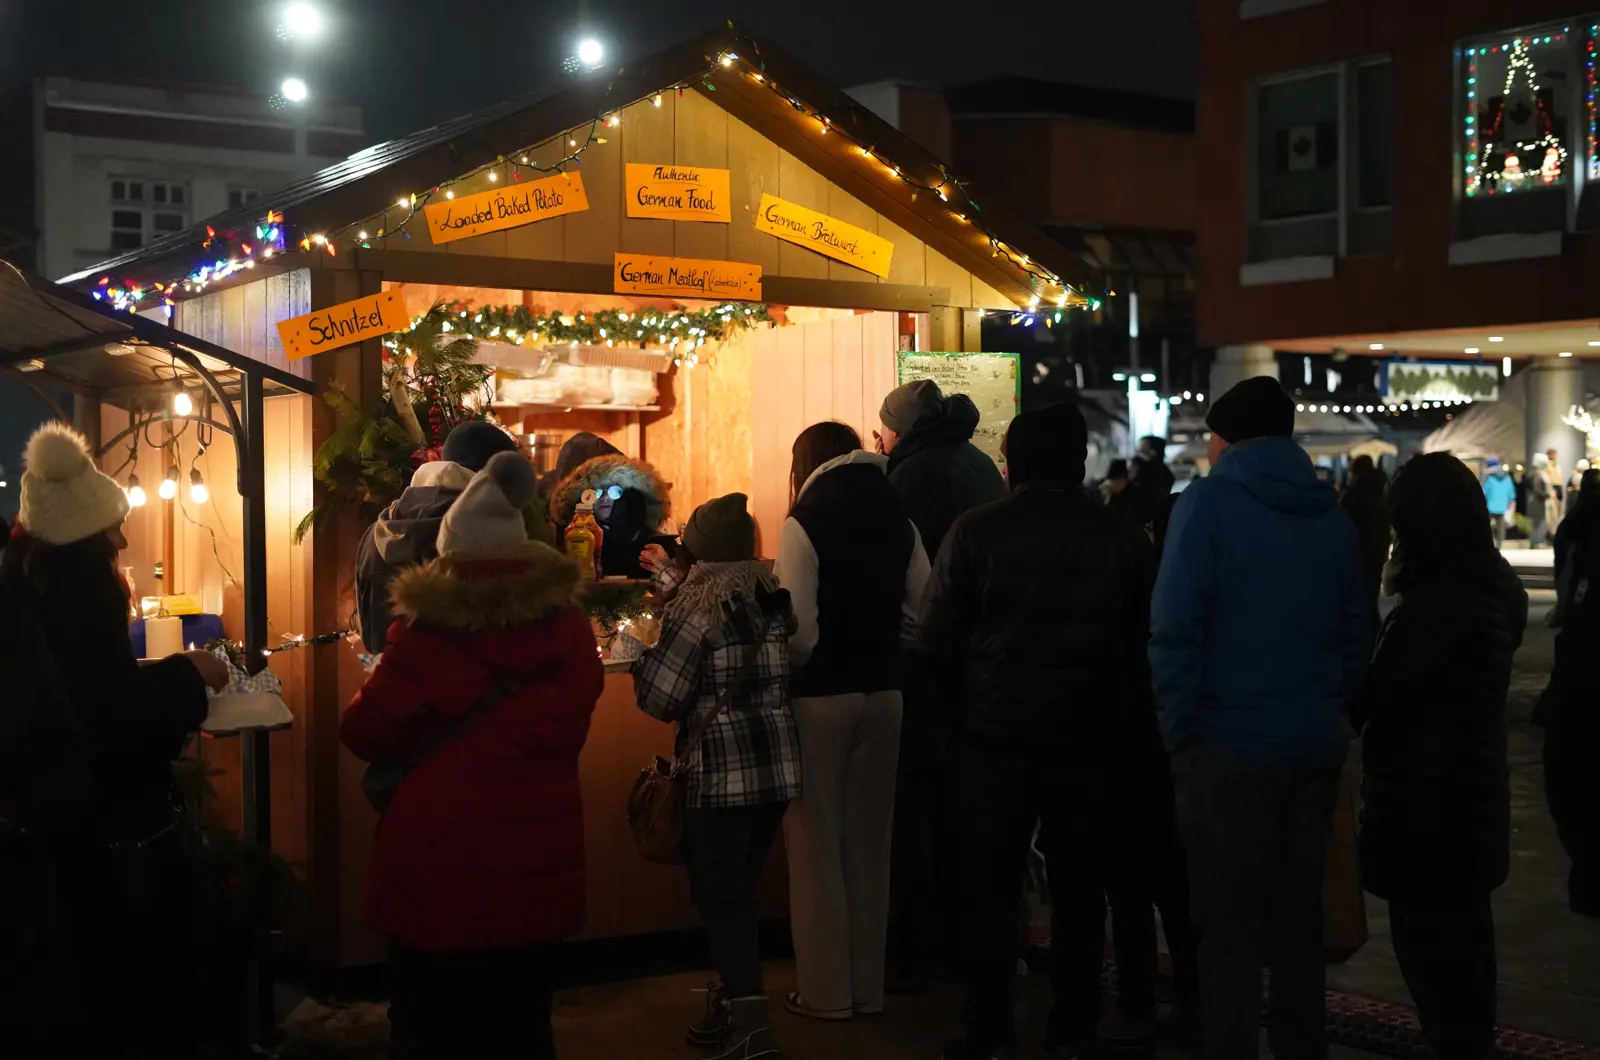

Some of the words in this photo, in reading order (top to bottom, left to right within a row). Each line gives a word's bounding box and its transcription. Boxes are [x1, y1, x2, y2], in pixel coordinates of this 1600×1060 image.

[653, 166, 700, 182] Authentic
[439, 203, 495, 232] Loaded
[532, 187, 564, 211] Potato
[637, 186, 684, 209] German
[685, 188, 716, 210] Food
[765, 204, 807, 235] German
[620, 262, 665, 284] German
[668, 267, 709, 293] Meatloaf
[308, 300, 384, 346] Schnitzel
